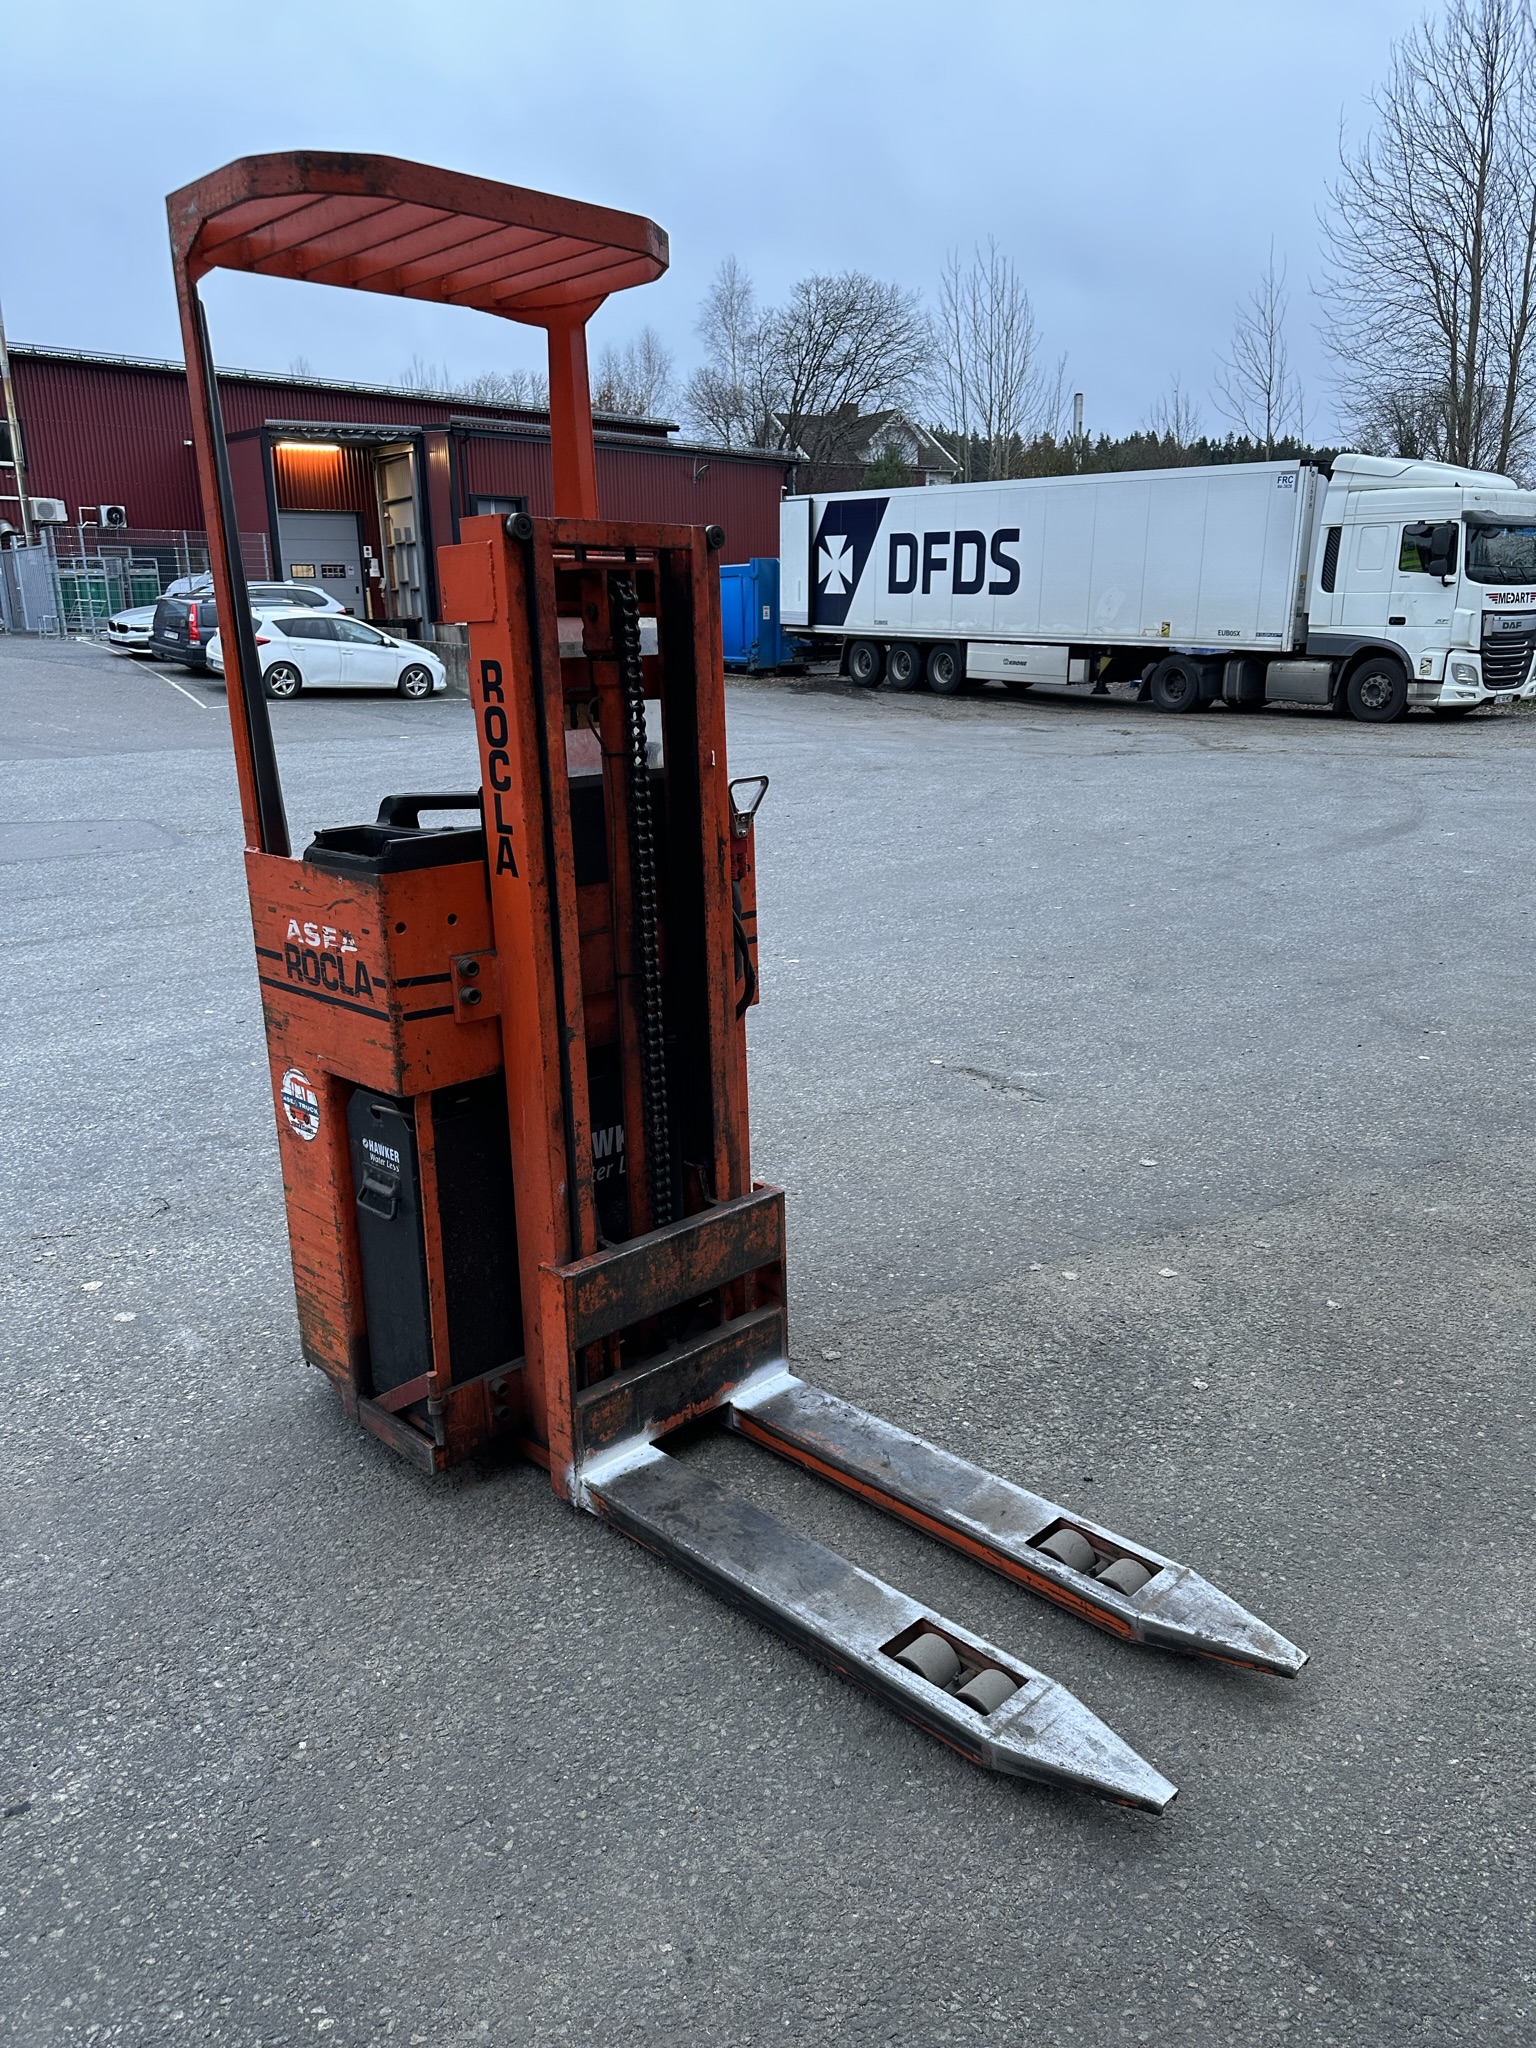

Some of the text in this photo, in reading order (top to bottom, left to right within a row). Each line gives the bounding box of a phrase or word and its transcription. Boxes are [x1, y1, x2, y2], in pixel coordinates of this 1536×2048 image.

[1277, 475, 1294, 484] FRC
[887, 527, 1021, 596] DFDS
[1498, 592, 1530, 604] MEDART
[1502, 621, 1522, 629] DAF
[480, 659, 519, 879] ROCLA
[284, 942, 375, 1002] ROCLA
[298, 1101, 319, 1116] TRUCK
[368, 1139, 400, 1164] HAWKER
[369, 1152, 400, 1173] Water Less
